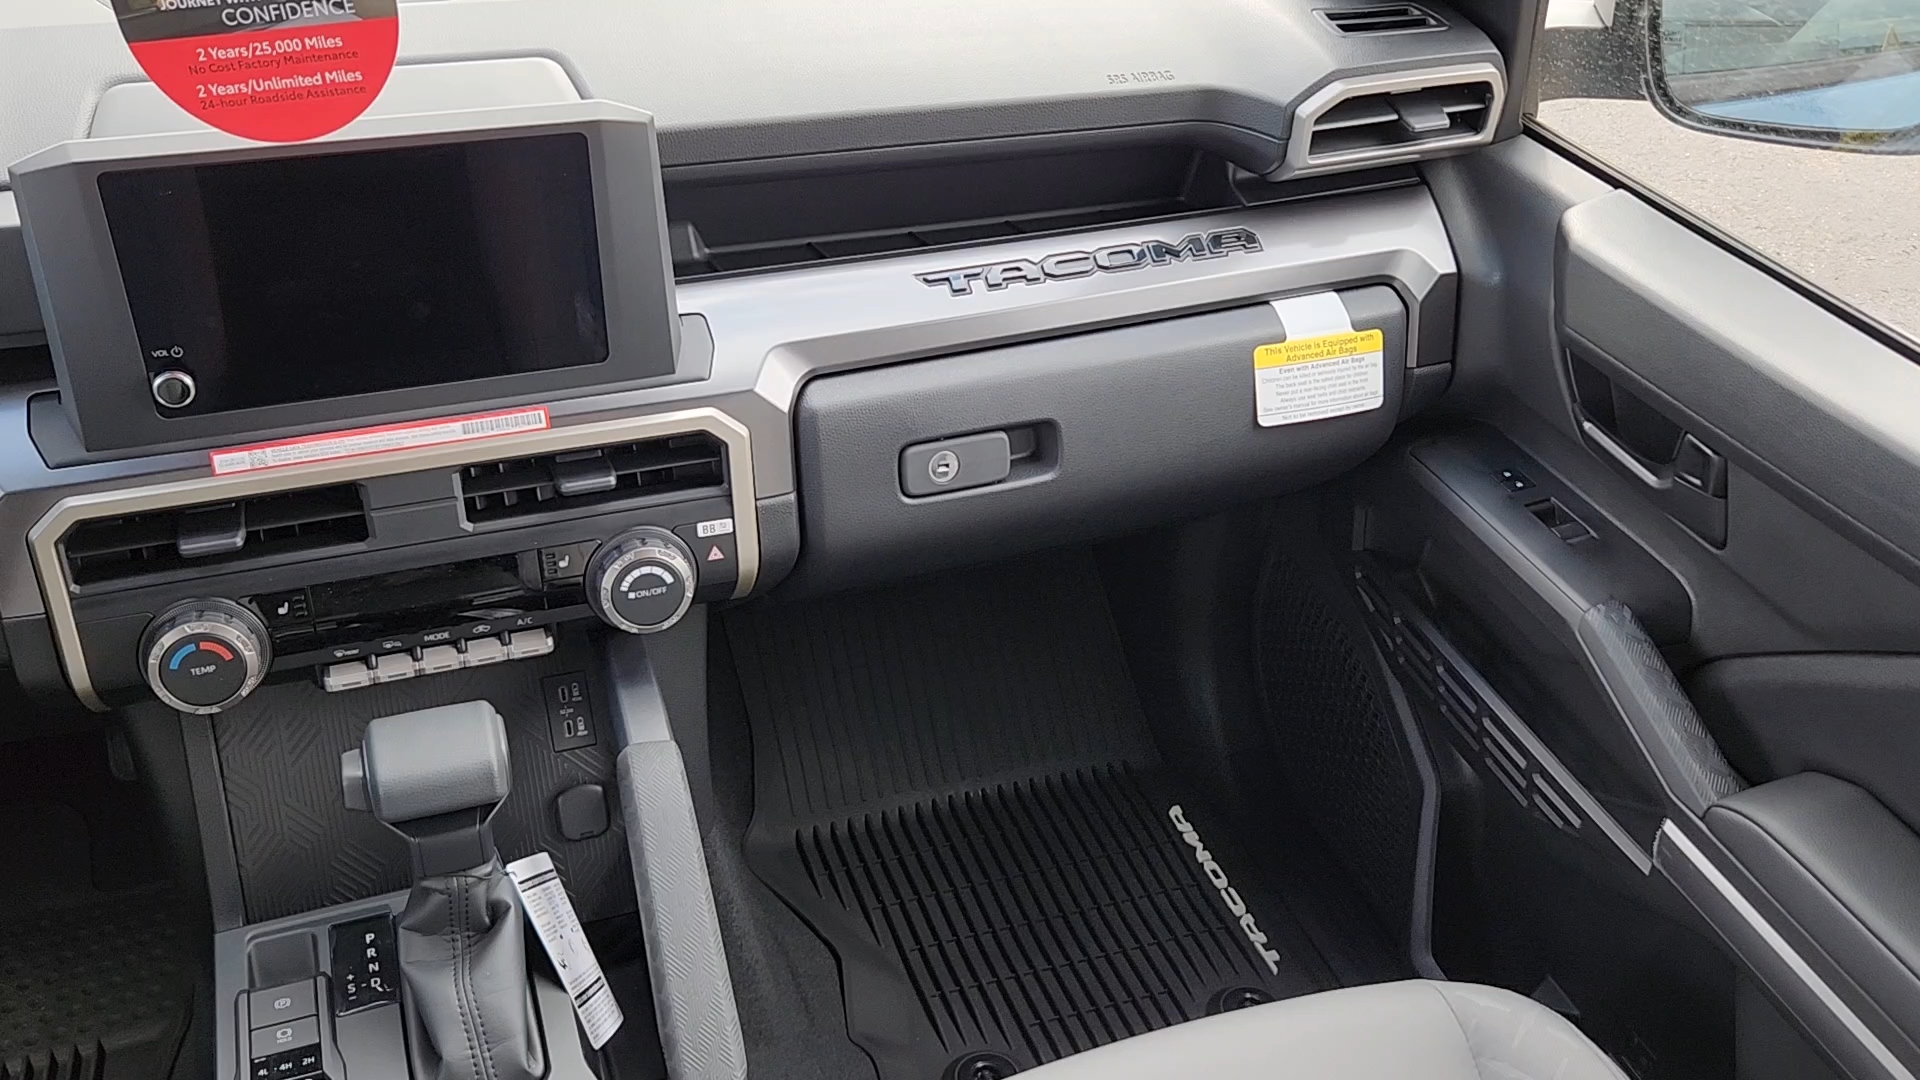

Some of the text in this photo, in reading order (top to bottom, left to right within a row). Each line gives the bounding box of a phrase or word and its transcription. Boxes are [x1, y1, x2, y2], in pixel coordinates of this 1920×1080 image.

[221, 0, 356, 26] CONFIDENCE
[196, 35, 343, 62] 2 Years/25,000 Miles
[188, 51, 359, 75] No Cost Factory Maintenance
[196, 69, 363, 98] 2 Years/Unlimited Miles
[200, 85, 367, 110] 24-hour Roadside Assistance
[913, 226, 1264, 297] TACOMA
[1264, 347, 1282, 356] This
[1284, 341, 1312, 353] Vehicle
[1322, 335, 1358, 348] Equipped
[1359, 334, 1374, 342] with
[151, 349, 169, 358] VOL
[1286, 346, 1358, 362] Advanced Air Bags
[702, 523, 716, 535] BB
[635, 586, 668, 598] ON/OFF
[516, 616, 533, 626] A/C
[424, 631, 450, 642] MODE
[190, 664, 217, 676] TEMP
[1168, 804, 1281, 976] TACOMA
[365, 933, 375, 944] P
[366, 947, 378, 959] R
[368, 962, 380, 973] N
[347, 983, 356, 993] S
[257, 1055, 315, 1076] 4L 4H 2H
